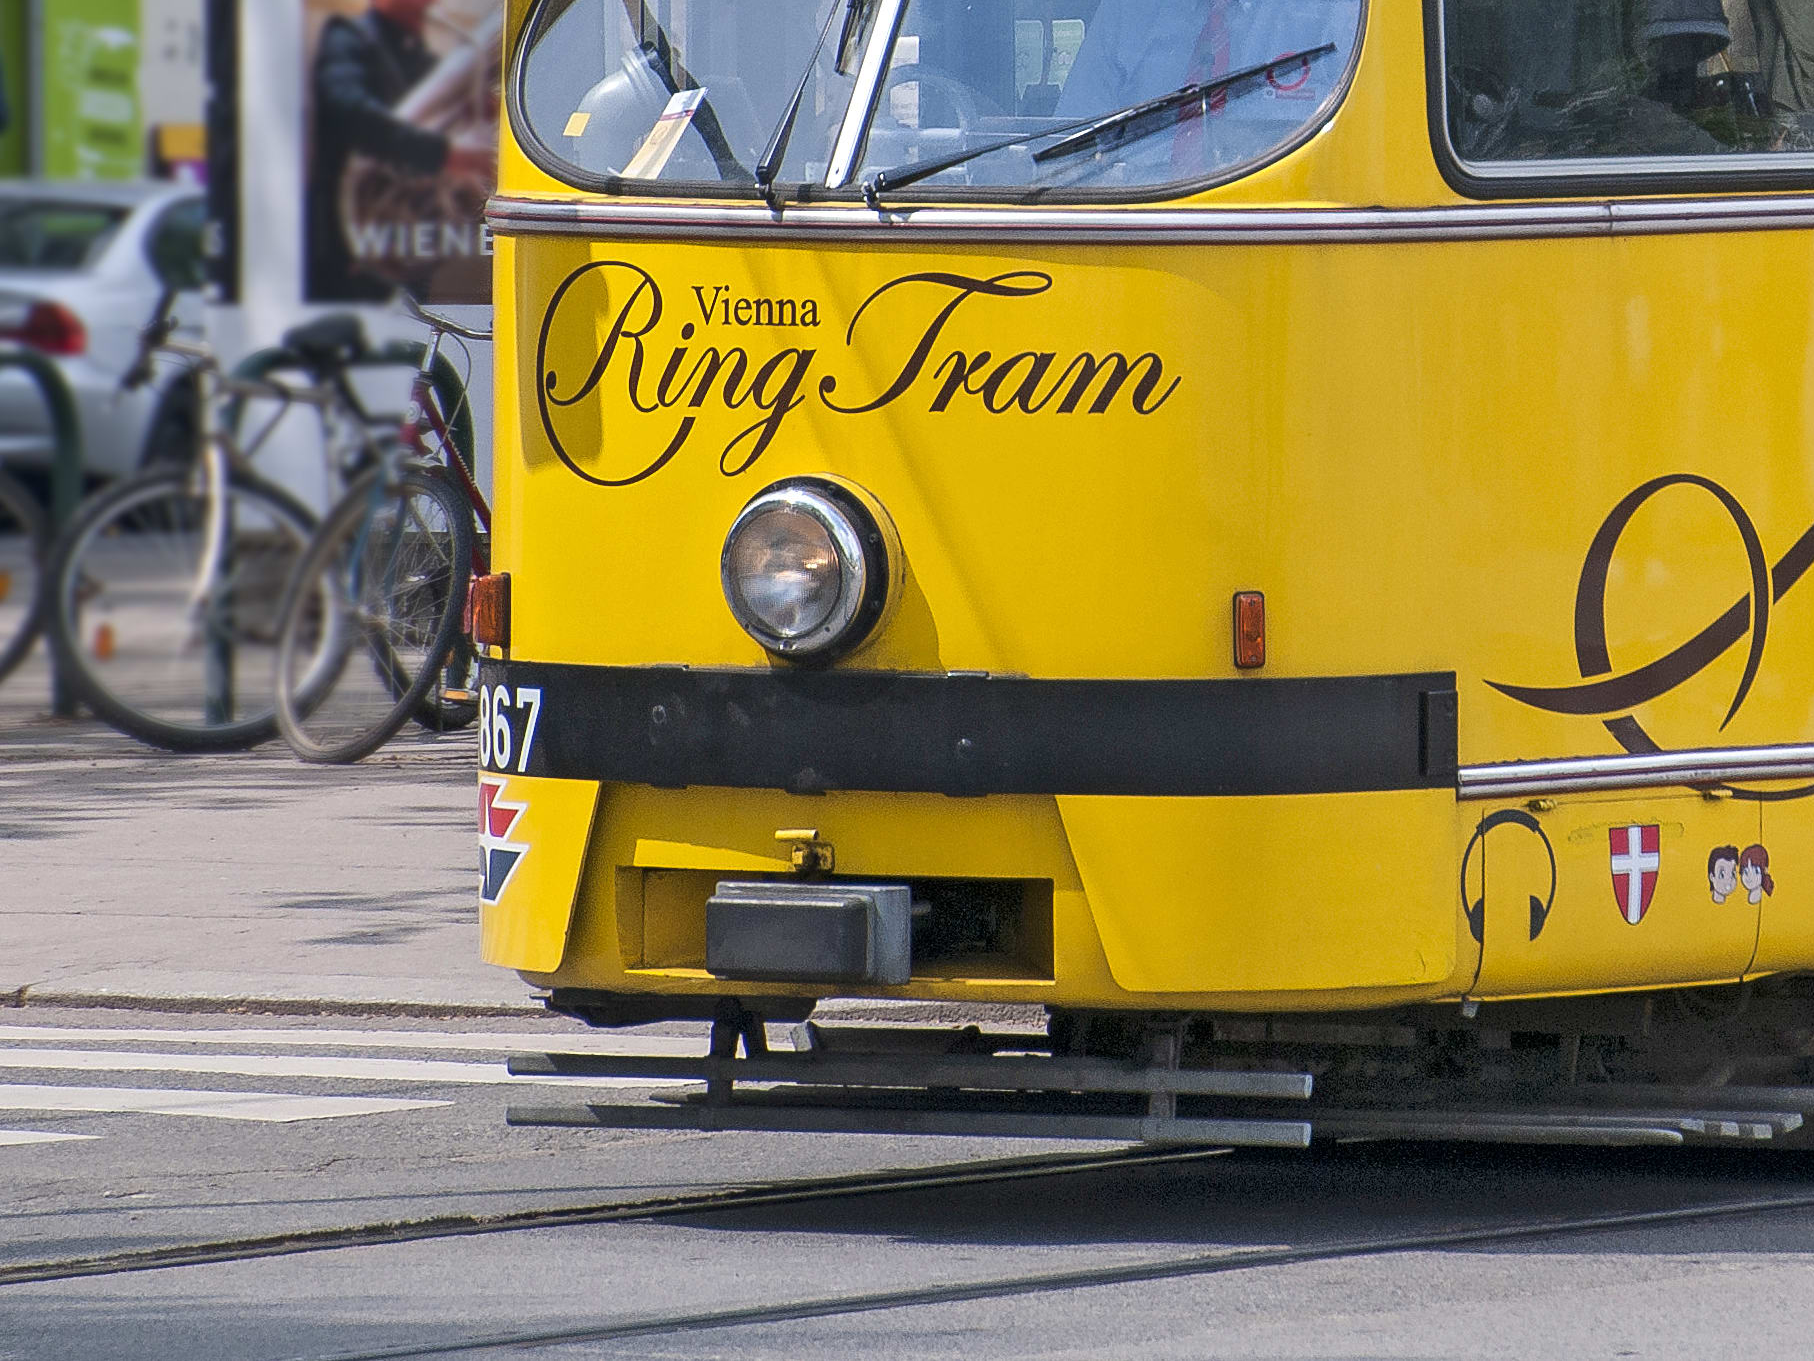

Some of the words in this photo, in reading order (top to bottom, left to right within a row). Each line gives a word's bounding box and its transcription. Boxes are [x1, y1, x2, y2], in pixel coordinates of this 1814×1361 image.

[536, 260, 817, 487] Ring
[818, 270, 1182, 416] Tram
[691, 284, 821, 329] Vienna
